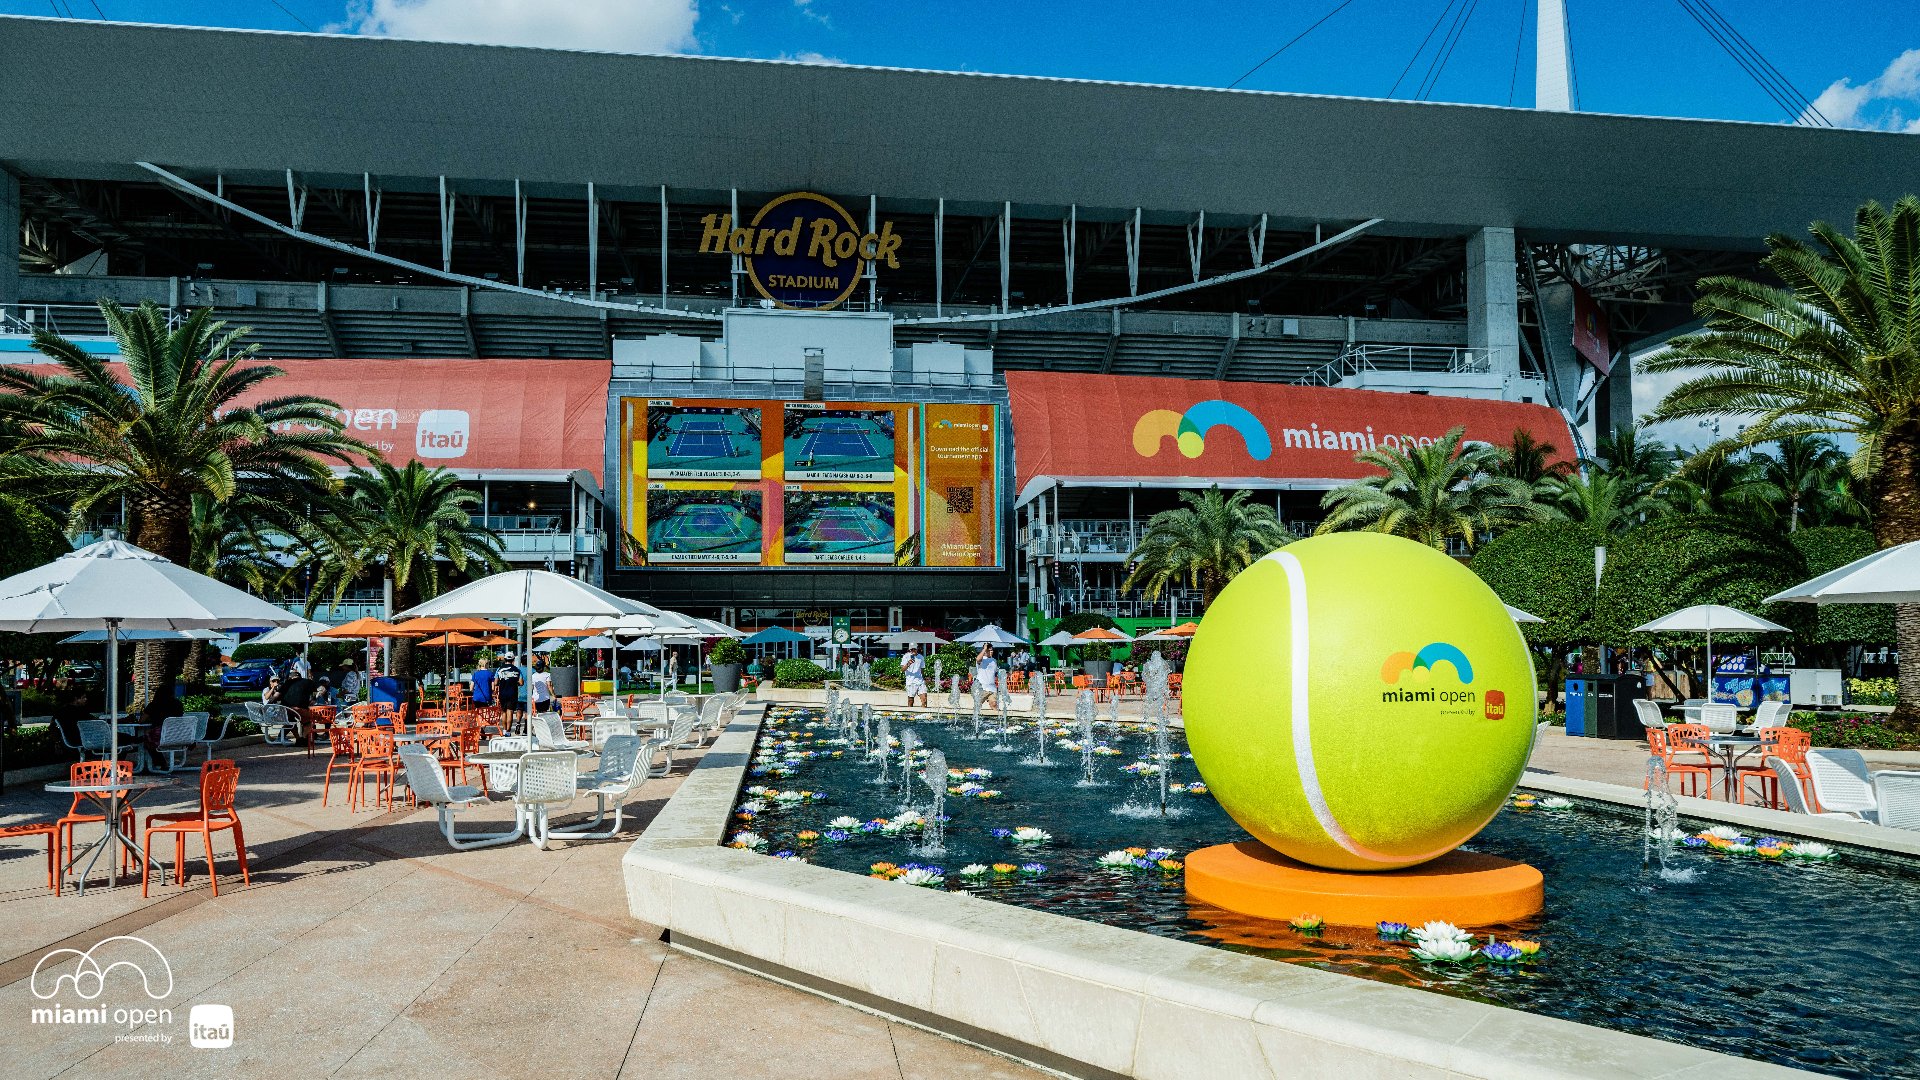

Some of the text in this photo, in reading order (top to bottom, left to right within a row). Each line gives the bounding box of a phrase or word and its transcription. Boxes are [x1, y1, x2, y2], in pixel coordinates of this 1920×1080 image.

[699, 213, 902, 269] Hard Rock
[768, 274, 839, 290] STADIUM
[1283, 422, 1376, 451] miami
[381, 441, 395, 453] by
[1382, 687, 1476, 705] miami open
